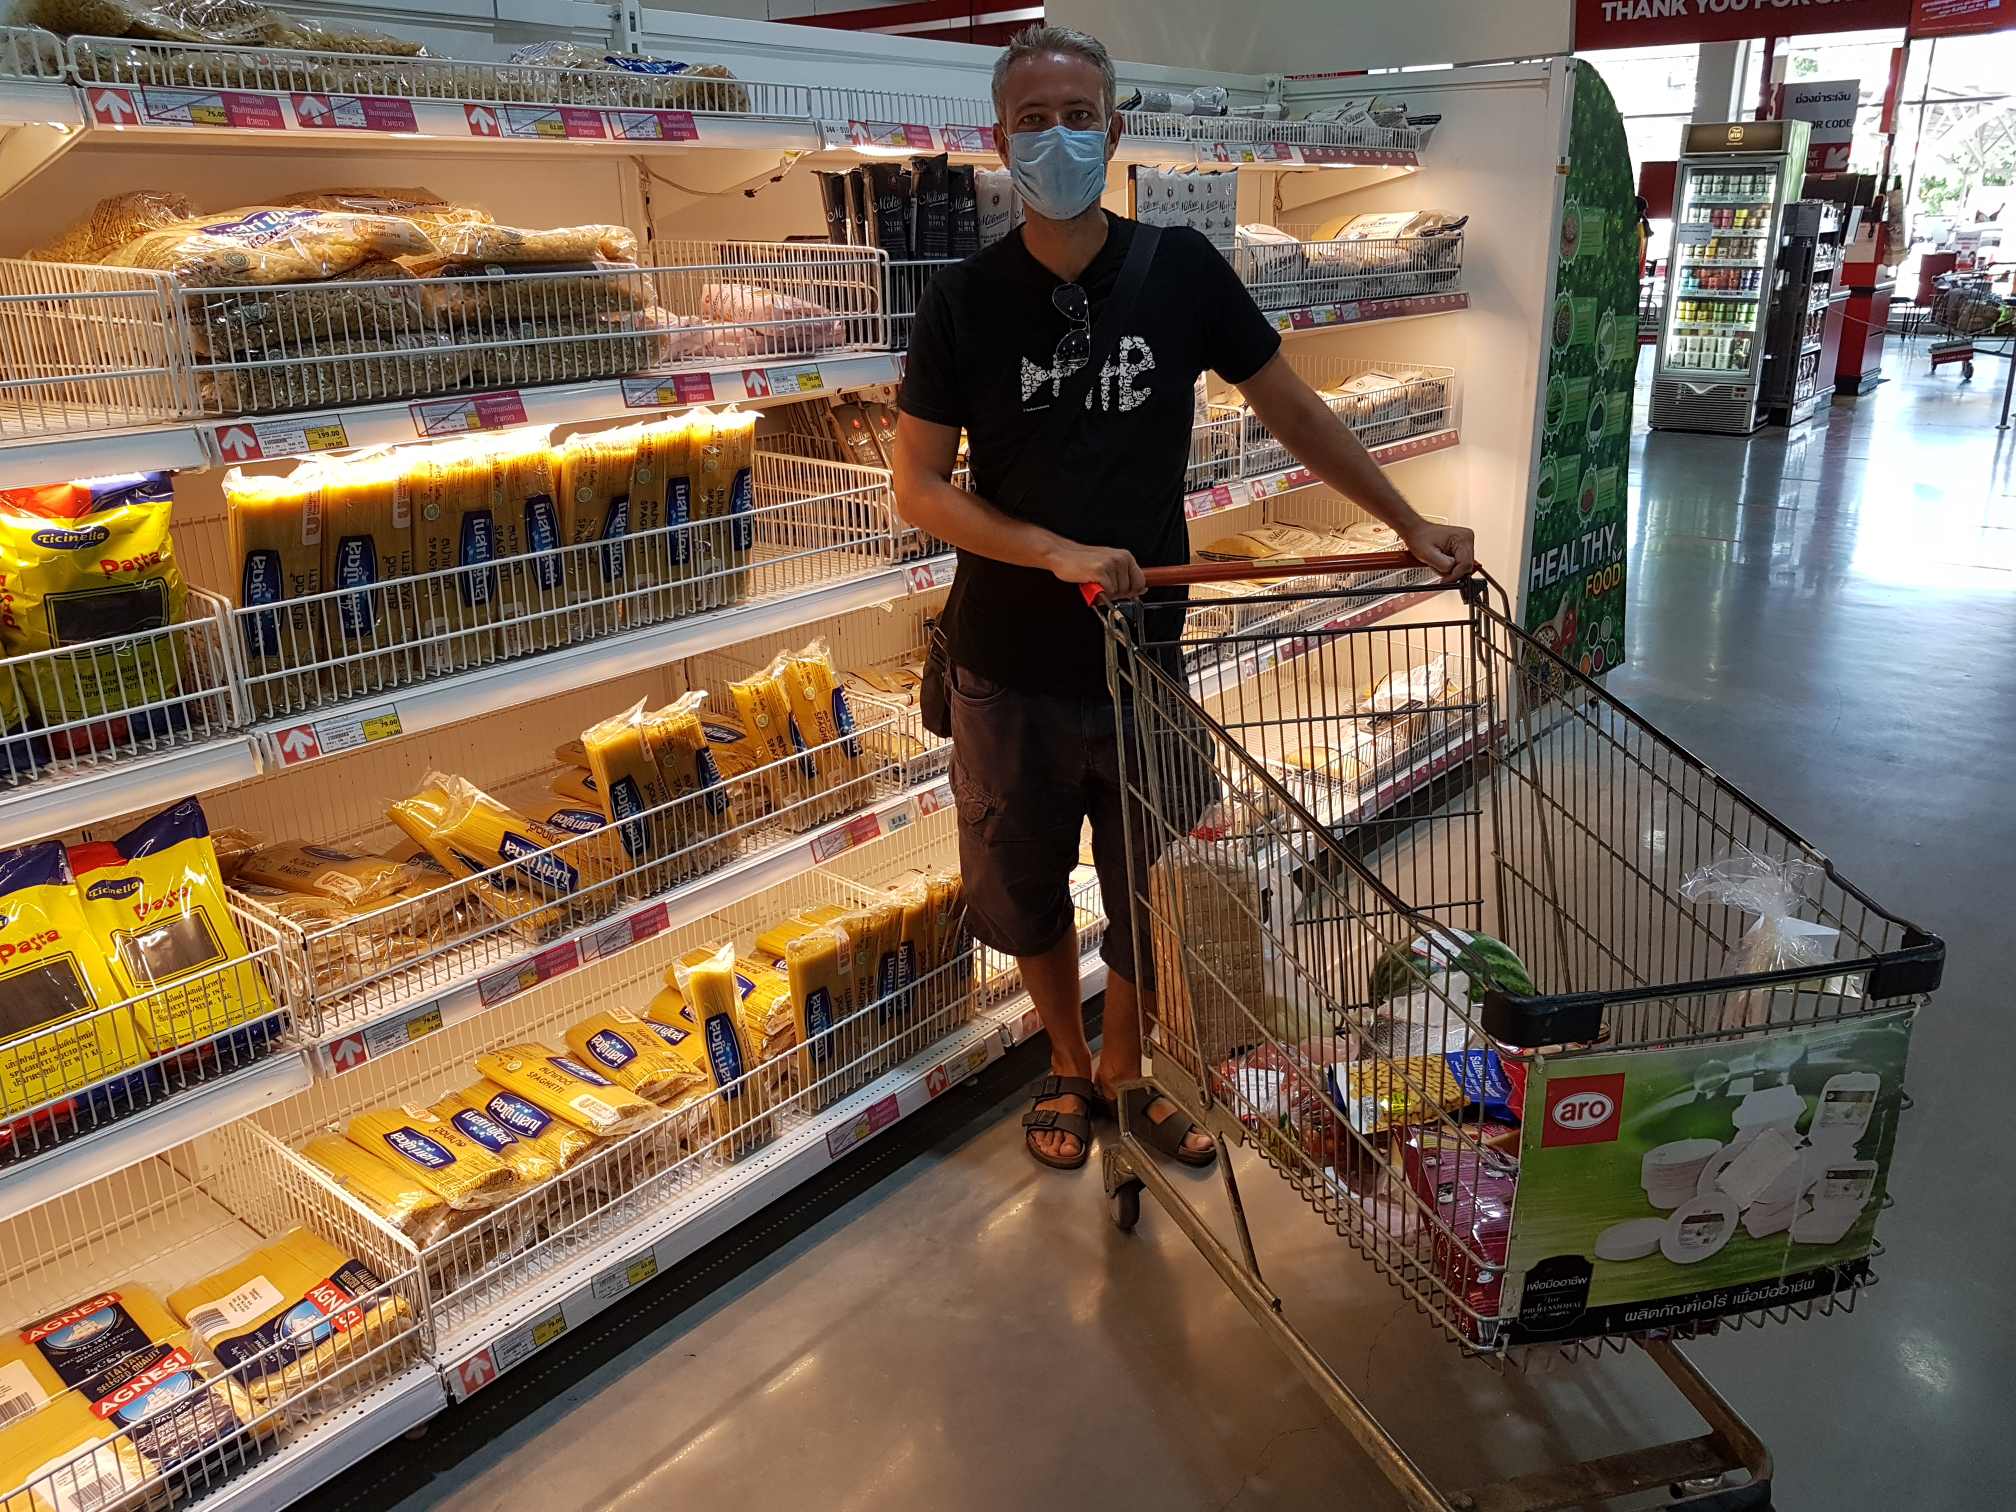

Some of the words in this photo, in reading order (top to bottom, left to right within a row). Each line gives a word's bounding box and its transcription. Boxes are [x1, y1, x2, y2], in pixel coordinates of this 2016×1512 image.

[1600, 0, 1689, 22] THANK
[1529, 522, 1618, 593] HEALTHY
[1584, 562, 1622, 600] FOOD
[0, 929, 62, 965] Pasta
[526, 1070, 566, 1094] SPAGHETTI
[1560, 1100, 1606, 1122] aro
[1527, 1276, 1588, 1292] เพื่อมืออาชีพ
[29, 1295, 118, 1342] AGNESI
[132, 1348, 162, 1372] QUALITY
[99, 1353, 188, 1415] AGNESI
